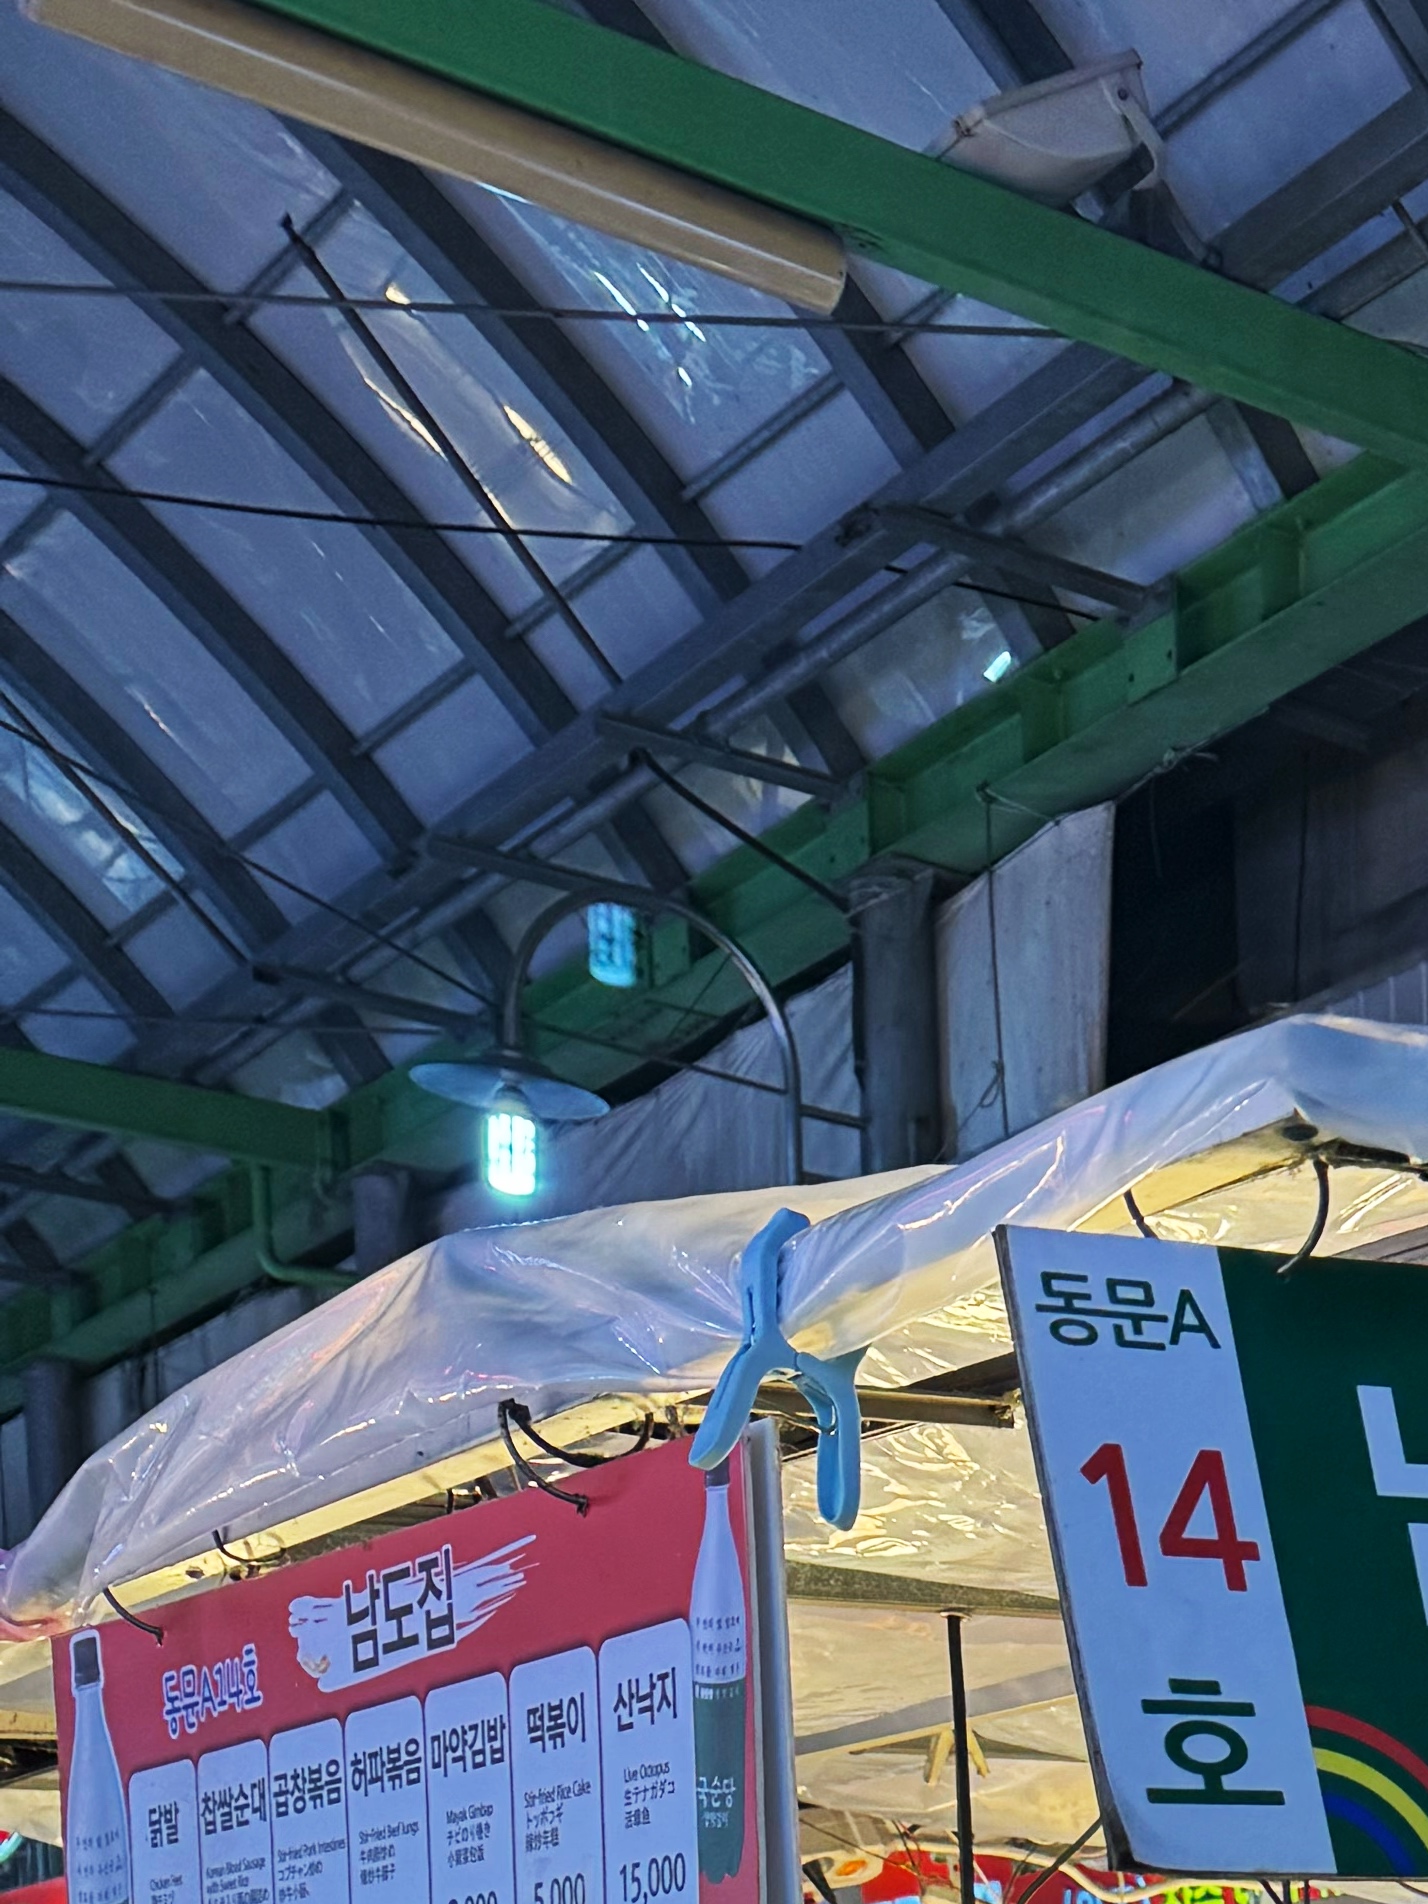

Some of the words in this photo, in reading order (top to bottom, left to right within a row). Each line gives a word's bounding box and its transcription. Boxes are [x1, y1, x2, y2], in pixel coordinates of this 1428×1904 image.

[1034, 1270, 1222, 1356] 동문A
[1079, 1441, 1262, 1594] 14
[344, 1544, 456, 1674] 남도집
[163, 1645, 262, 1738] 동문A14호
[526, 1692, 586, 1752] 떡볶이
[613, 1667, 677, 1732] 산낙지
[350, 1738, 423, 1797] 허파볶음
[430, 1714, 506, 1777] 마약김밥
[1140, 1677, 1286, 1808] 호
[201, 1777, 268, 1836] 찹쌀순대
[272, 1759, 343, 1818] 곱창볶음
[148, 1801, 180, 1848] 닭발
